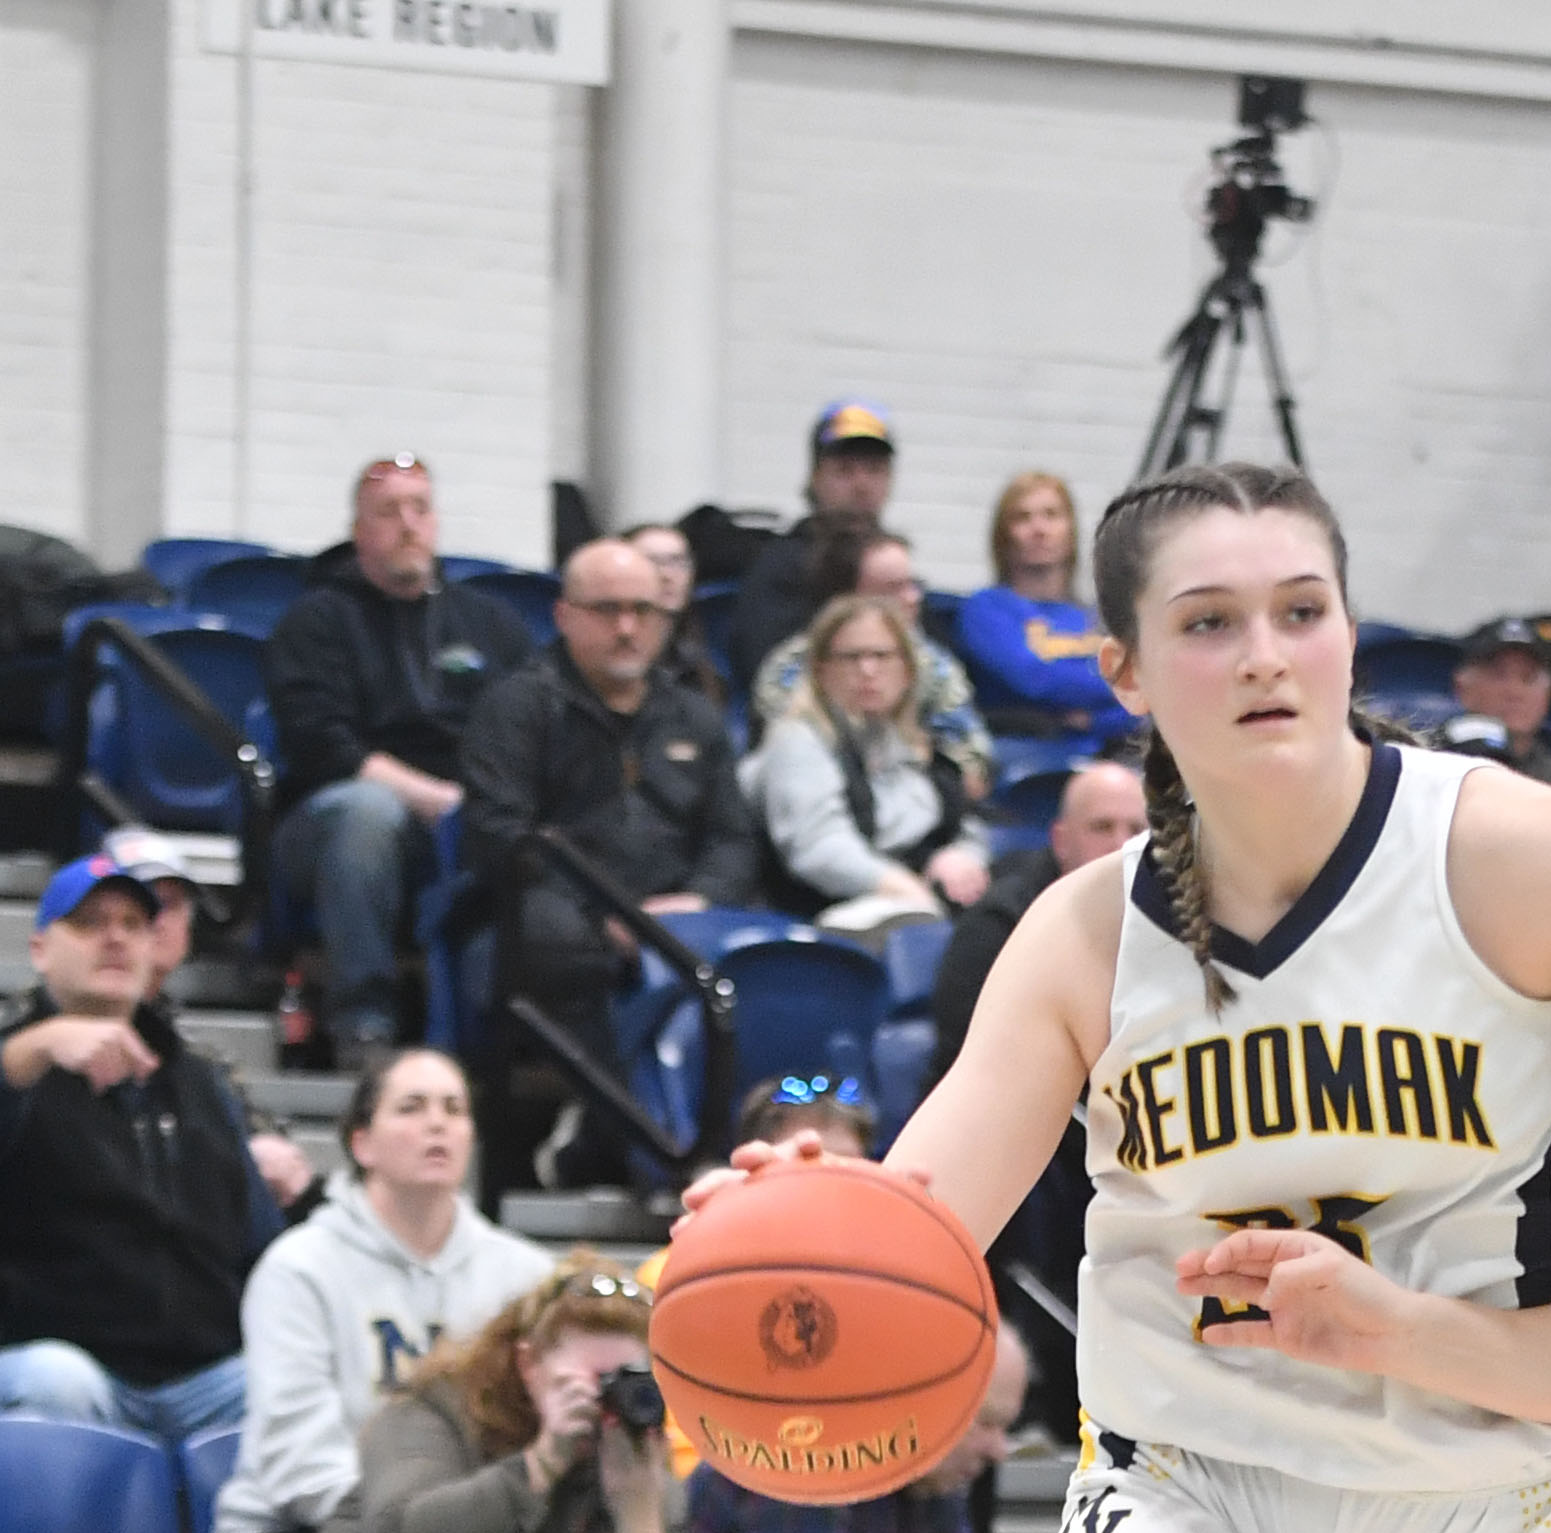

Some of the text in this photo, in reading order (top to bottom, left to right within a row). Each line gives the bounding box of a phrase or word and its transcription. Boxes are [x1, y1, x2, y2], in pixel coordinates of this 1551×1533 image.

[255, 0, 558, 55] LAKE REGION
[698, 1413, 920, 1473] SPALDING
